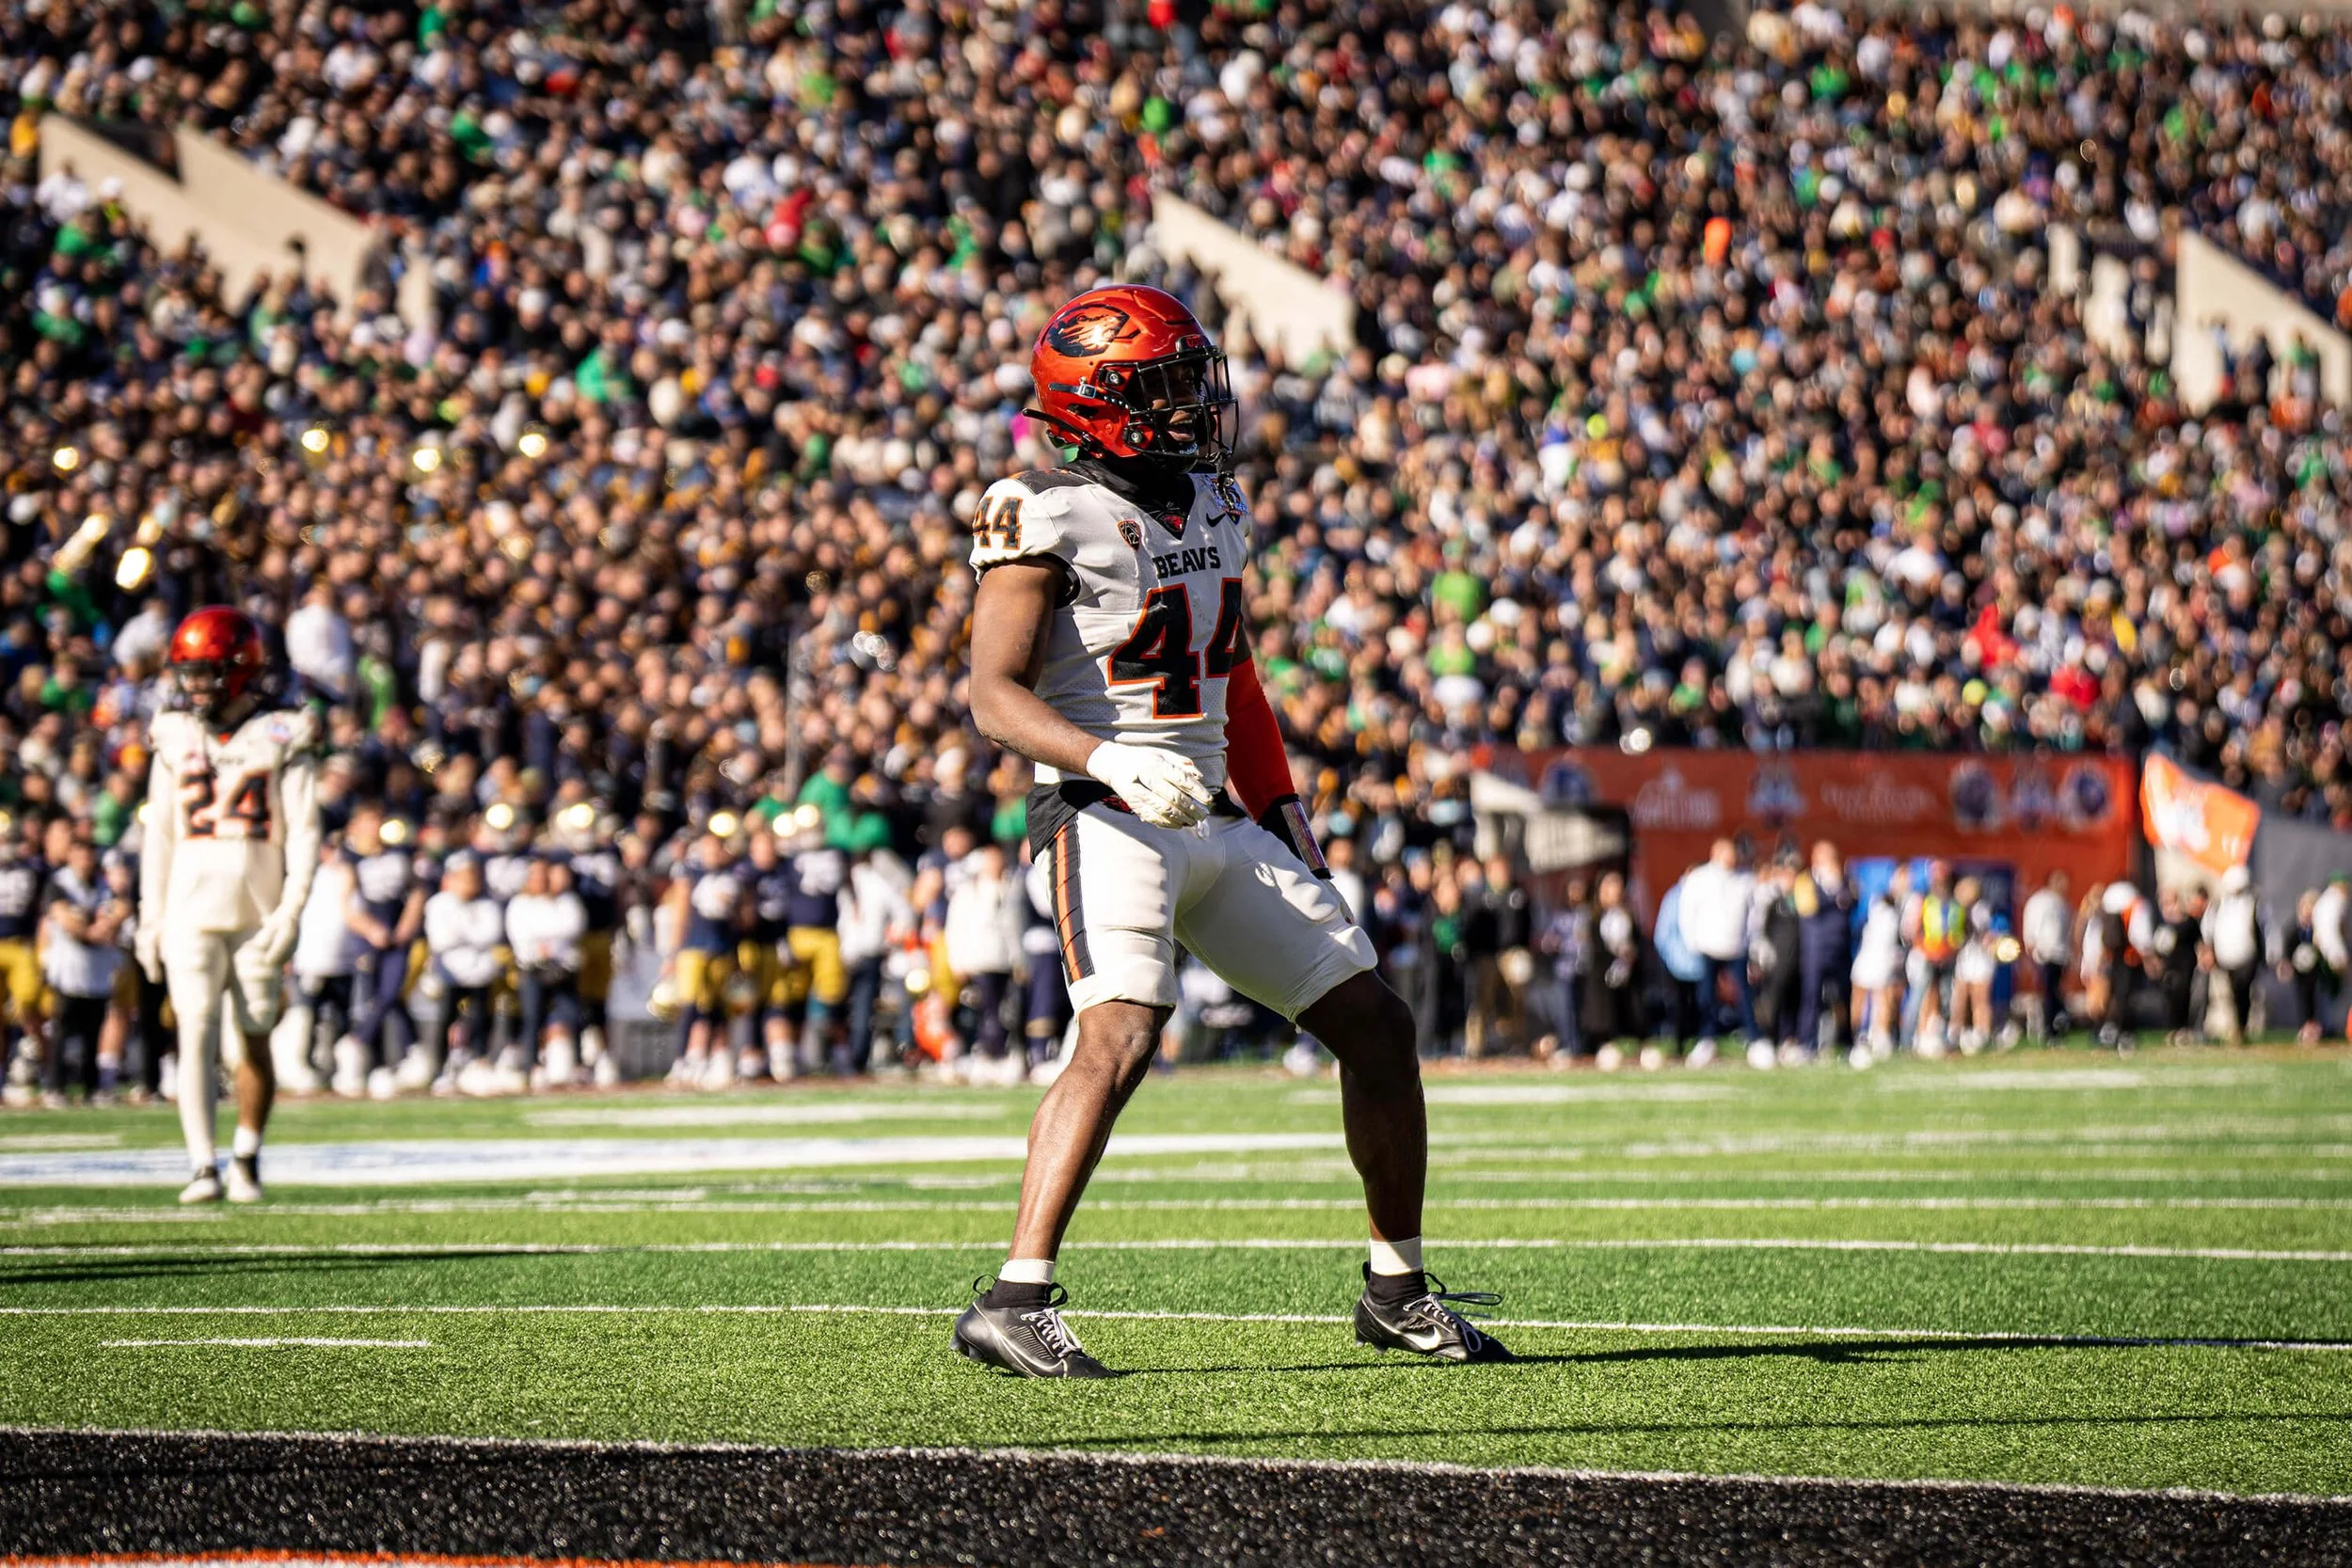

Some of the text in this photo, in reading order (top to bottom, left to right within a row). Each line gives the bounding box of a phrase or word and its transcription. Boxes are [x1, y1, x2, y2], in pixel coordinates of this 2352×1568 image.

[973, 497, 1023, 549] 44
[1153, 546, 1220, 578] BEAVS
[181, 770, 270, 839] 24
